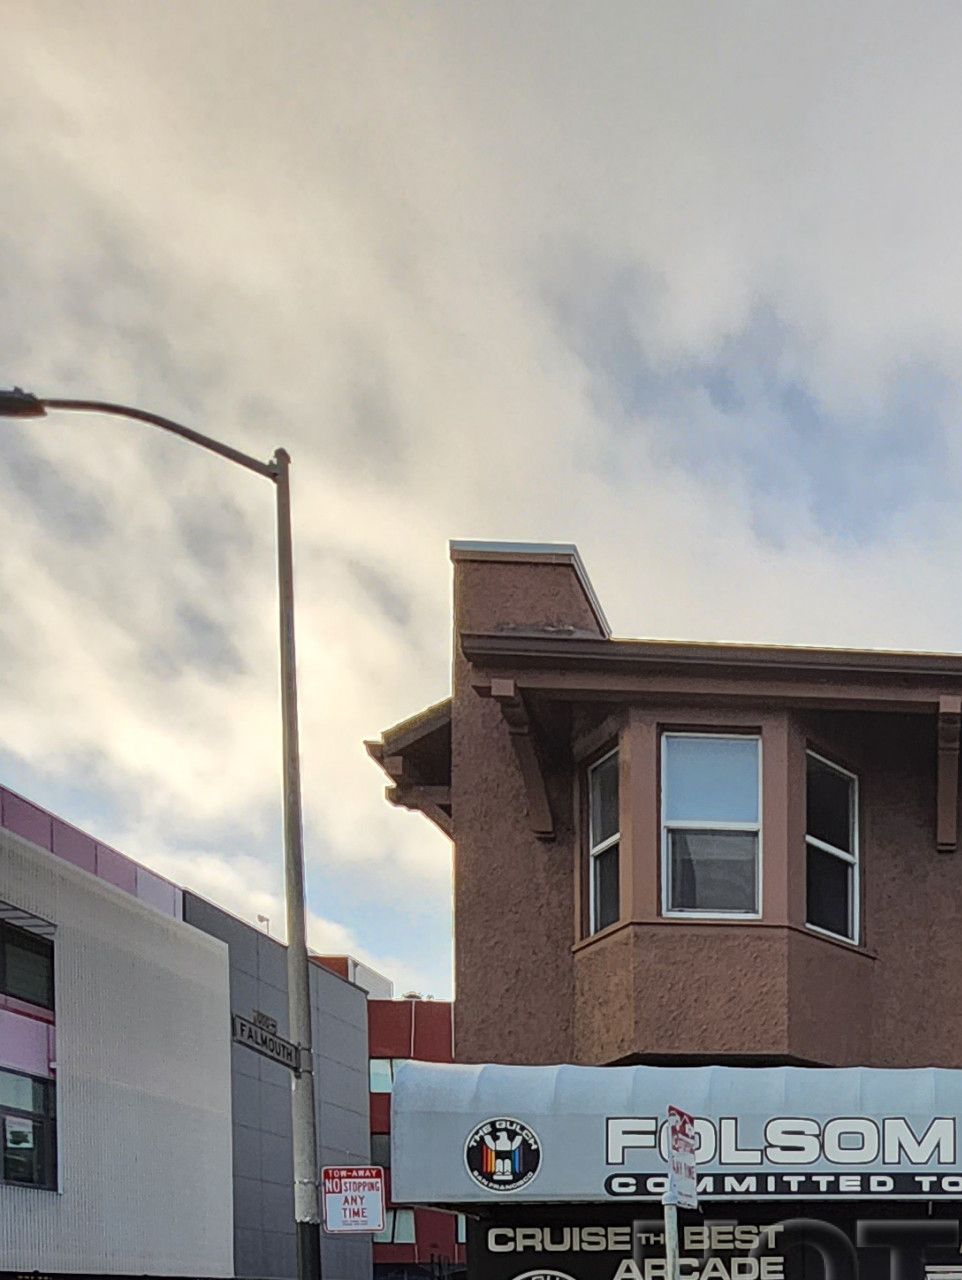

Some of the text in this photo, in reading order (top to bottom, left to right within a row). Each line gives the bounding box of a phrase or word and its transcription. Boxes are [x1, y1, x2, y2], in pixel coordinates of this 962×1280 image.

[240, 1022, 293, 1062] FALMOUTH
[469, 1121, 538, 1150] THE GULCH
[606, 1116, 956, 1166] FOLSOM
[327, 1170, 377, 1178] TOW-AWAY
[473, 1170, 534, 1190] SAN FRANCISCO
[325, 1179, 380, 1193] NO STOPPING
[343, 1195, 365, 1206] ANY
[342, 1208, 368, 1218] TIME
[487, 1225, 784, 1252] CRUISE TH BEST
